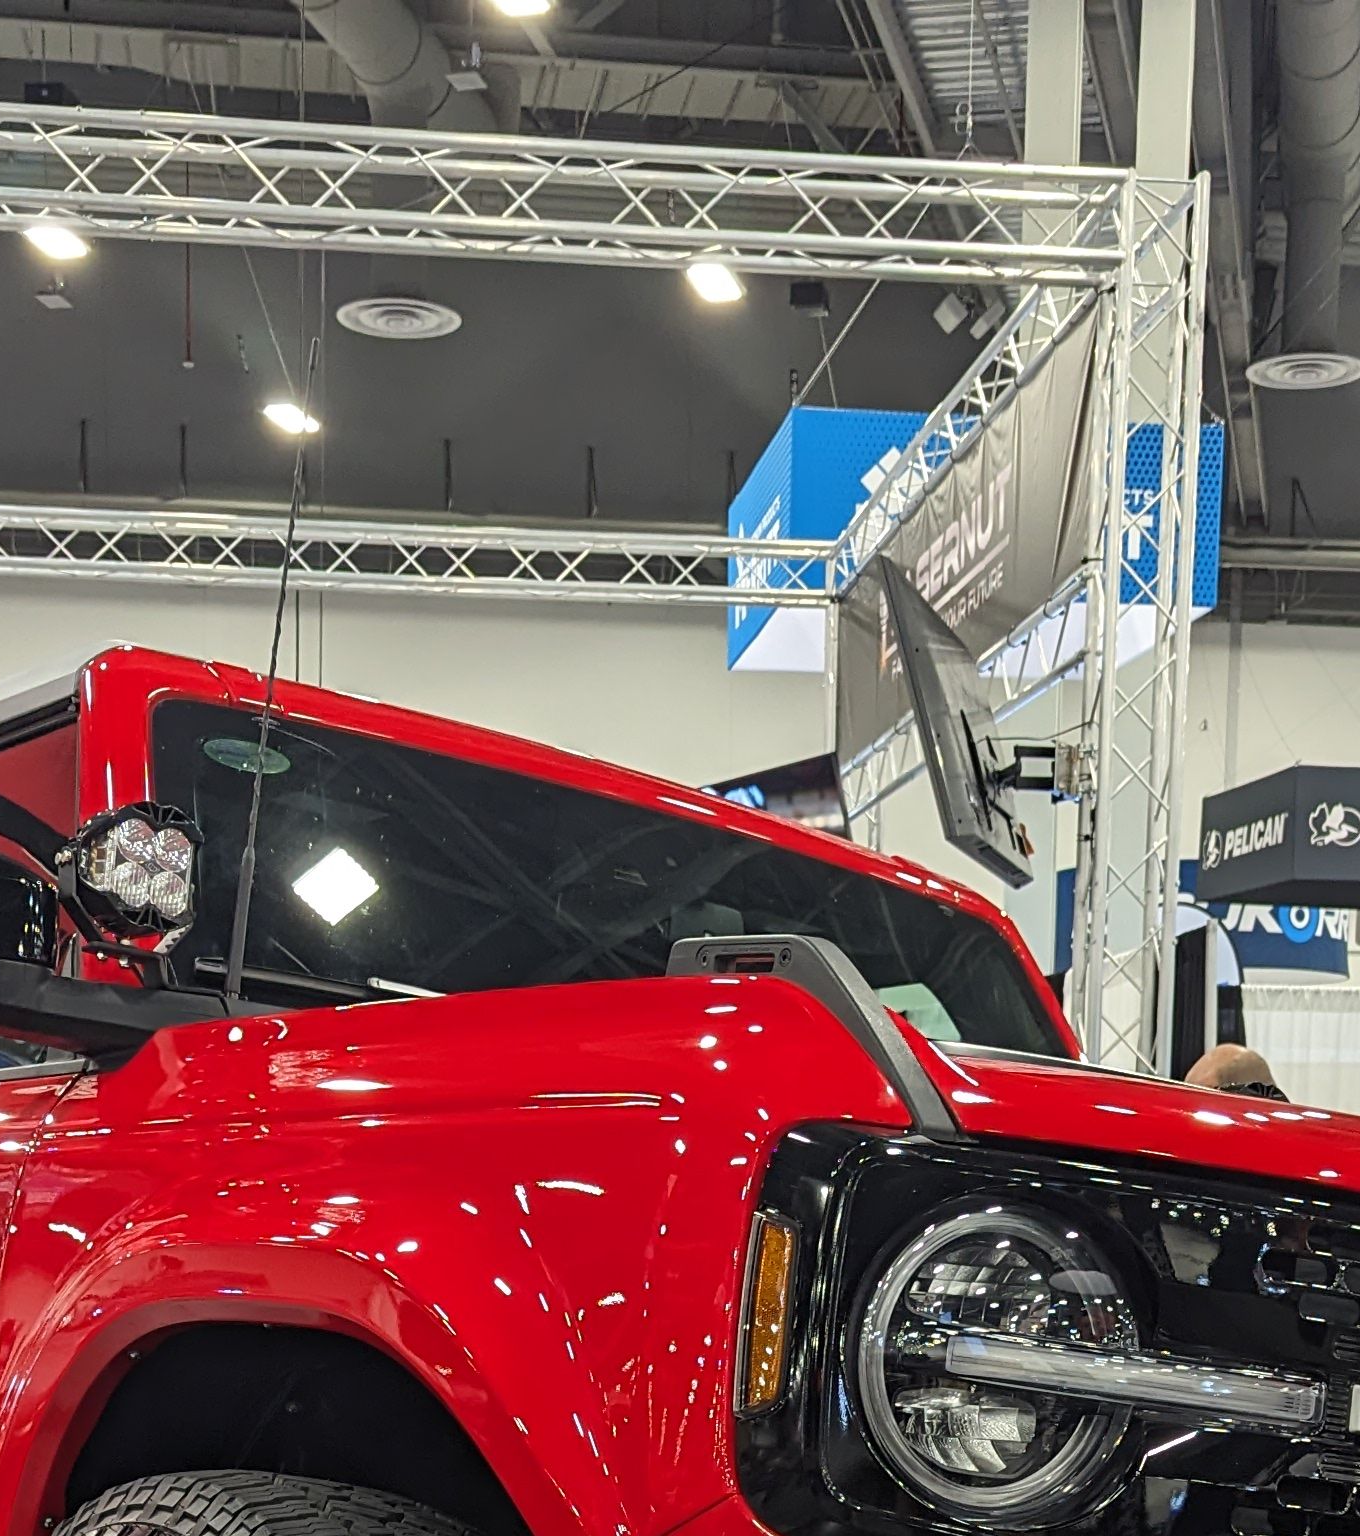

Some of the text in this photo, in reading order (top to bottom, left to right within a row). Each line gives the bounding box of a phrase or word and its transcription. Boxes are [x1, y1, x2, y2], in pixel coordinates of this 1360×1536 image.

[906, 463, 1011, 601] SERNUT
[968, 562, 1004, 615] FUTURE
[1223, 814, 1286, 861] PELICAN
